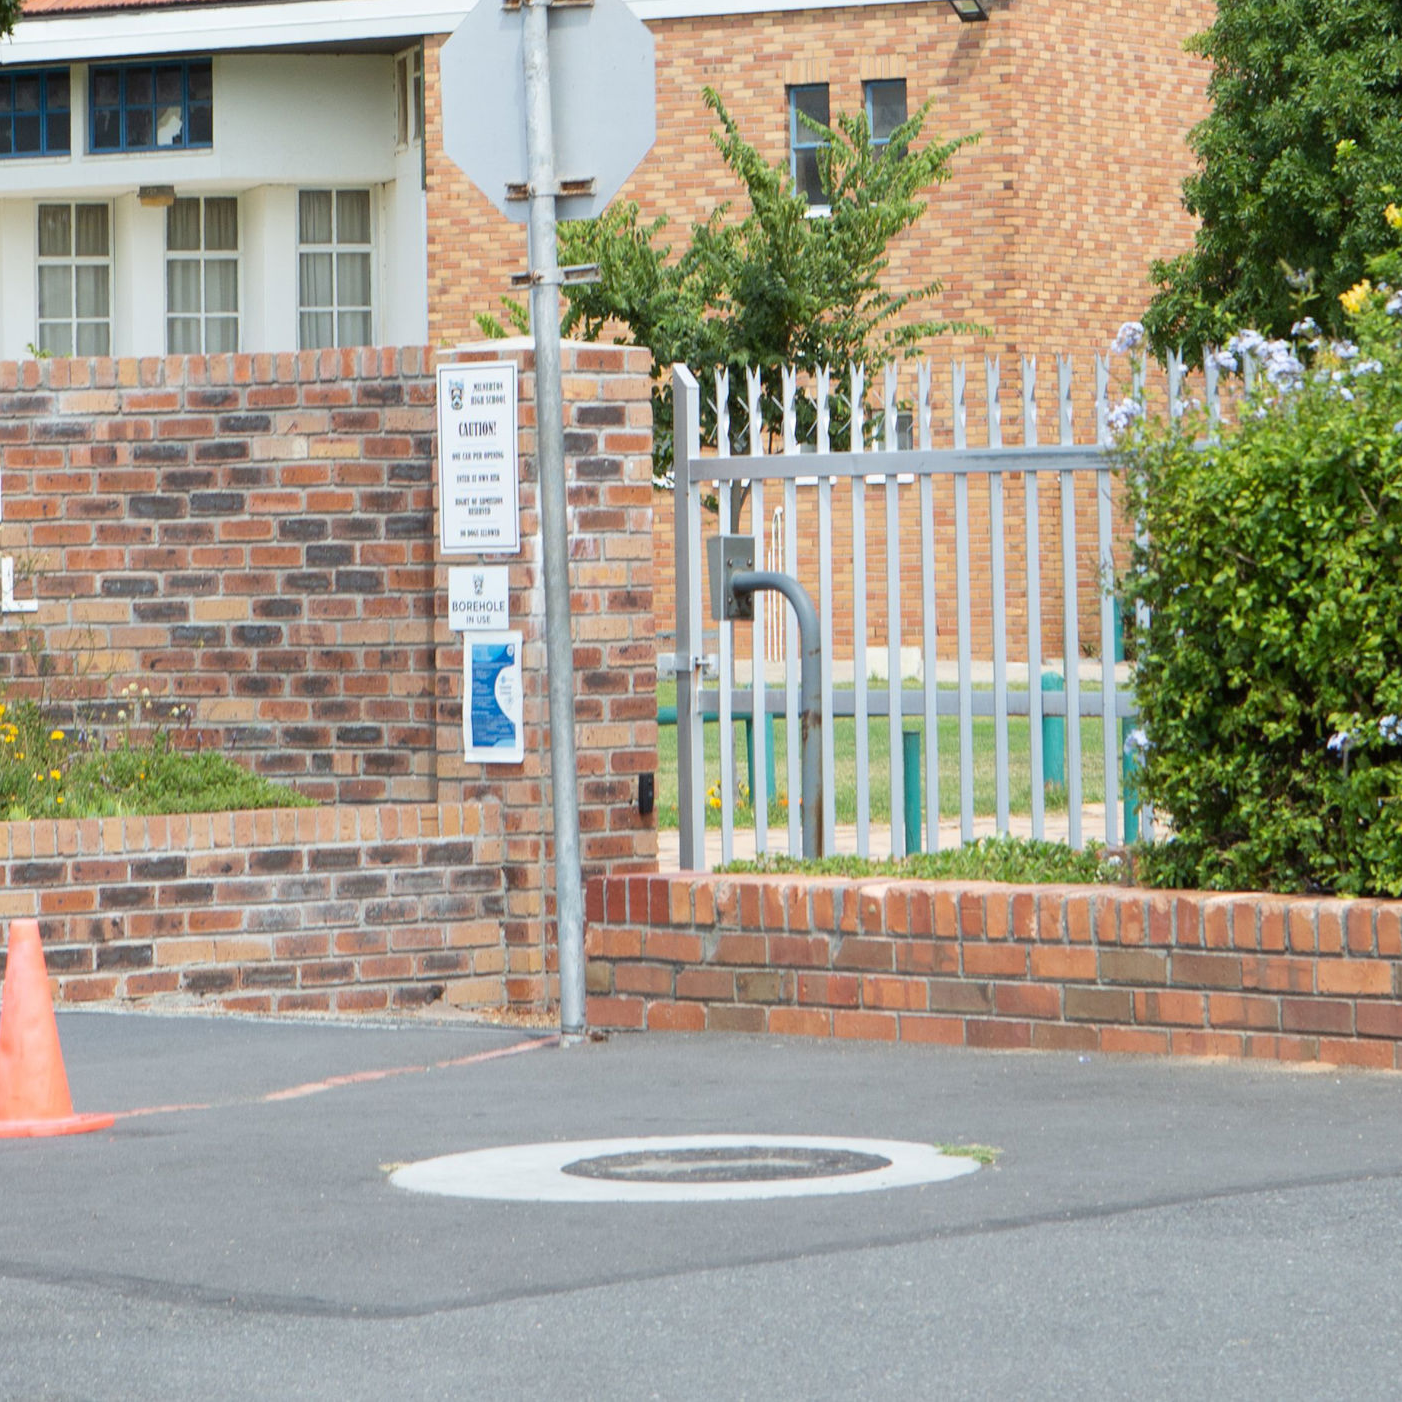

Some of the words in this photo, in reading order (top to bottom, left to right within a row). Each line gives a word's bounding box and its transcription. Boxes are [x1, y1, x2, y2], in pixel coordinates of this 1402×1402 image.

[470, 394, 486, 406] HIGH
[486, 394, 507, 406] SCHOOL
[458, 421, 497, 438] CAUTION!
[451, 600, 506, 612] BOREHOLE
[466, 615, 475, 625] IN
[476, 615, 491, 625] USE
